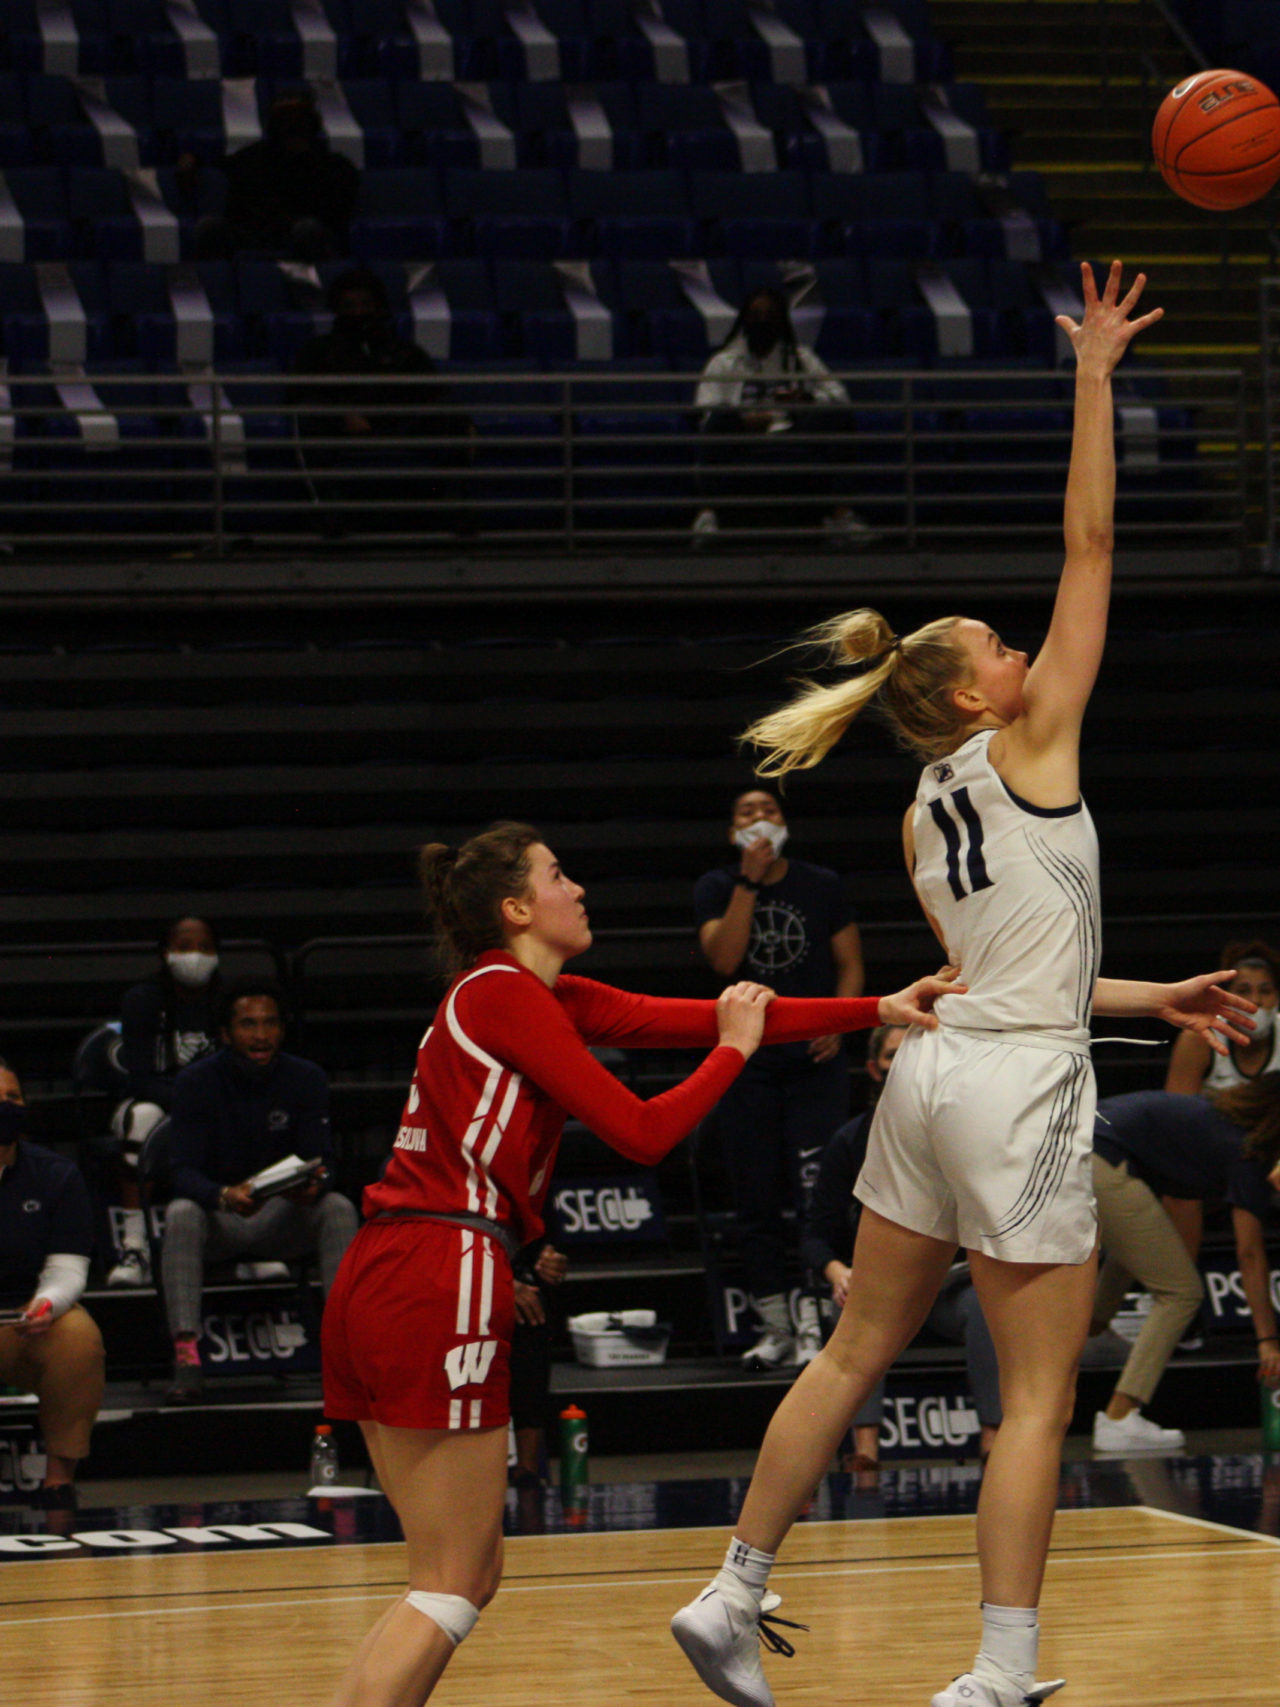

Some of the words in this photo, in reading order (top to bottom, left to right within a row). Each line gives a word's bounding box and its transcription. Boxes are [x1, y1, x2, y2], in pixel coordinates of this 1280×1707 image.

[928, 786, 995, 902] 11
[554, 1186, 654, 1233] SECU
[444, 1340, 498, 1392] W
[879, 1395, 981, 1448] SECU
